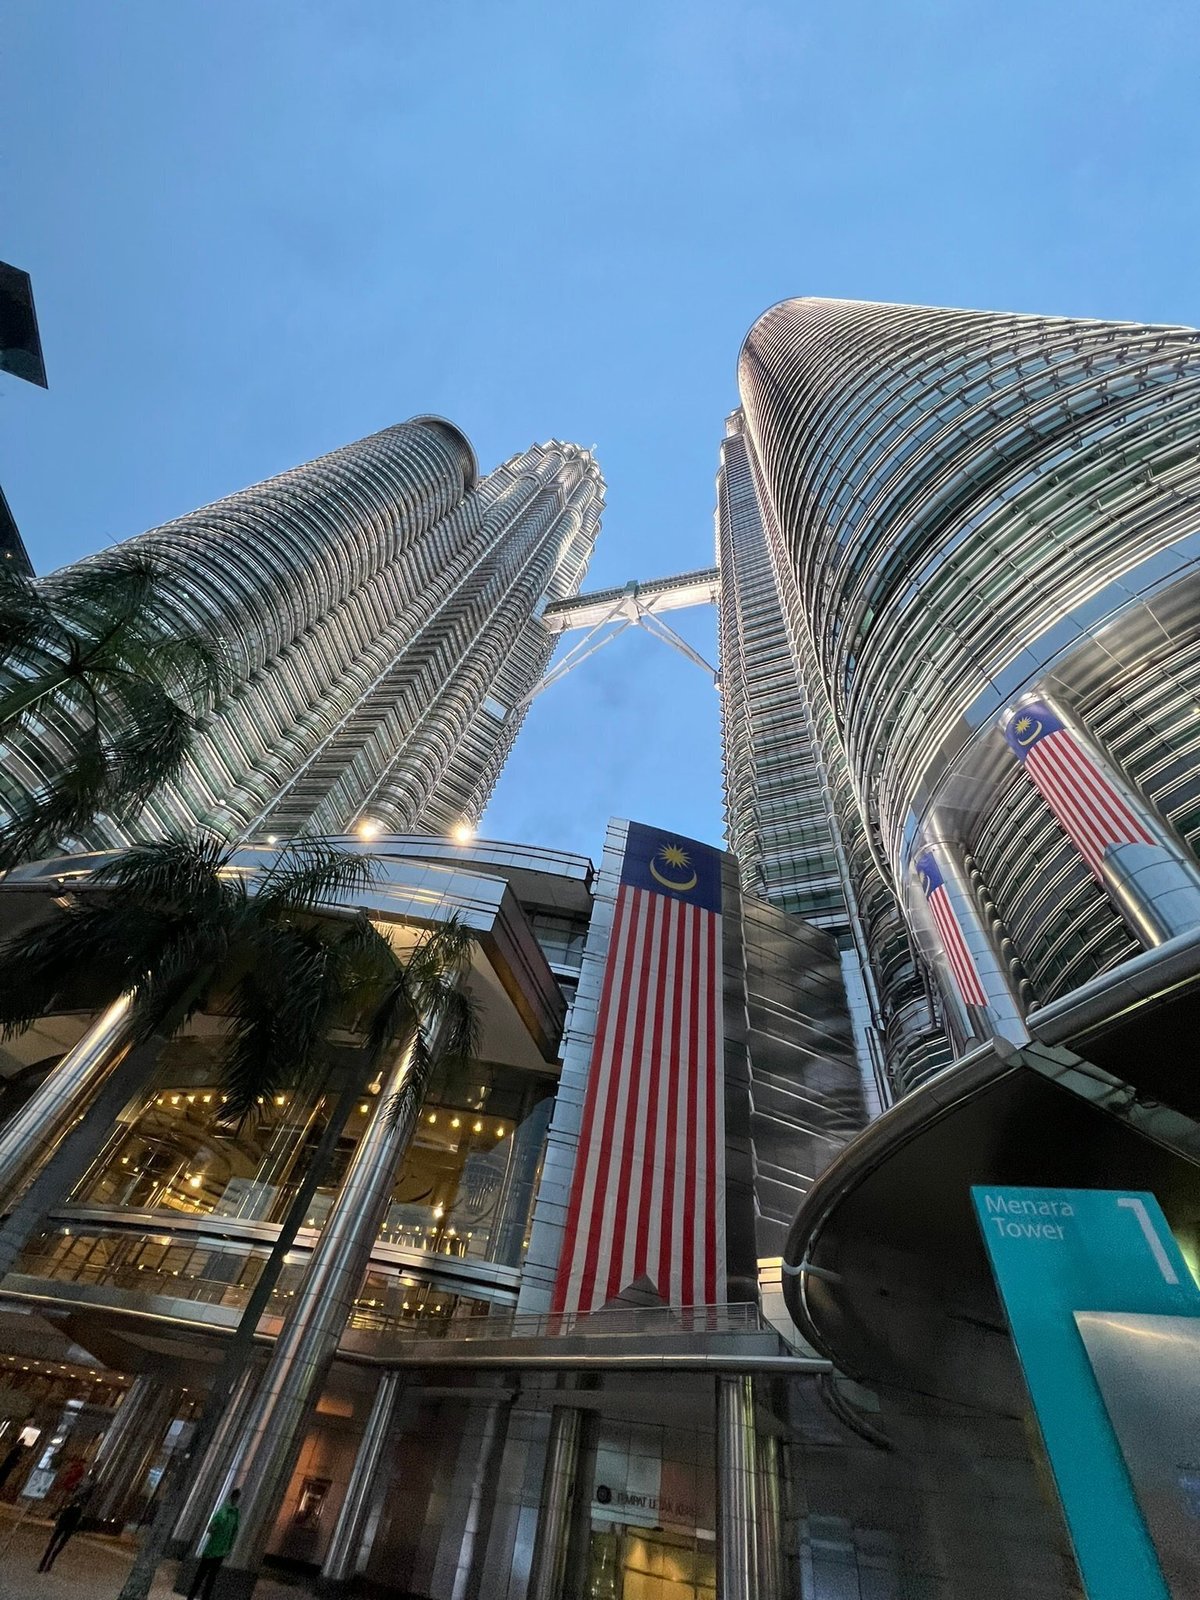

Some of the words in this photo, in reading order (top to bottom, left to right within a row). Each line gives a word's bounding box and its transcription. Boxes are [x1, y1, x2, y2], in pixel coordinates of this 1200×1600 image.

[985, 1194, 1075, 1217] Menara
[991, 1217, 1065, 1240] Tower
[1117, 1198, 1179, 1284] 1
